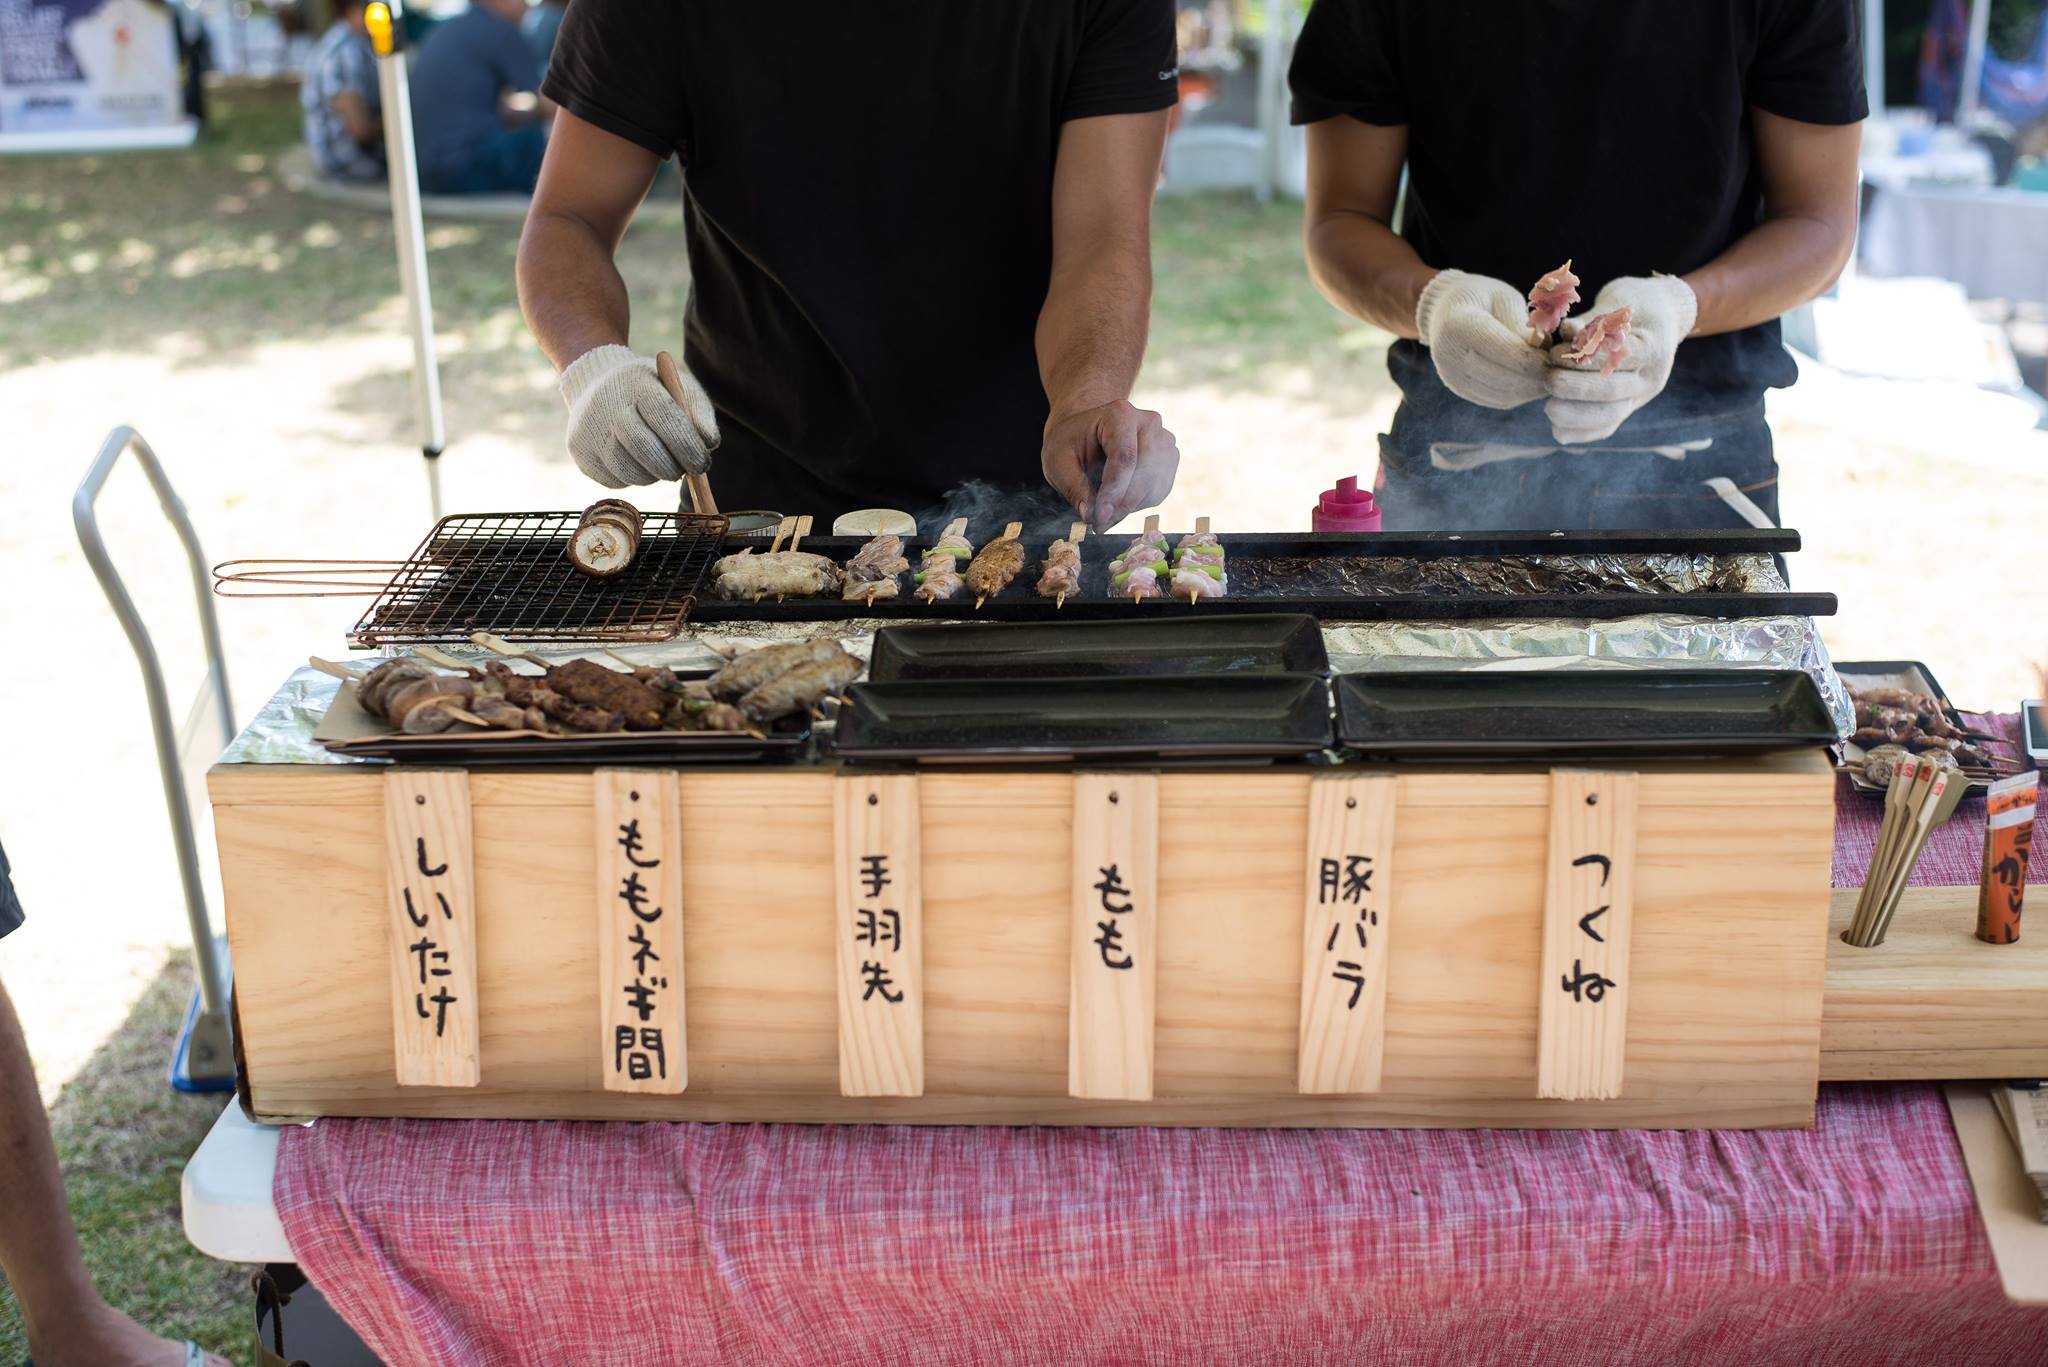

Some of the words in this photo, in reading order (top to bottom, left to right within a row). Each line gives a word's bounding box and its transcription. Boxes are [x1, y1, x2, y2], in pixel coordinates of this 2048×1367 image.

[403, 837, 457, 1038] しいたけ
[615, 819, 668, 1081] ももネギ間
[856, 855, 904, 1003] 手羽先
[1093, 864, 1133, 970] もも
[1319, 855, 1377, 1010] 豚バラ
[1561, 854, 1616, 1003] つくね
